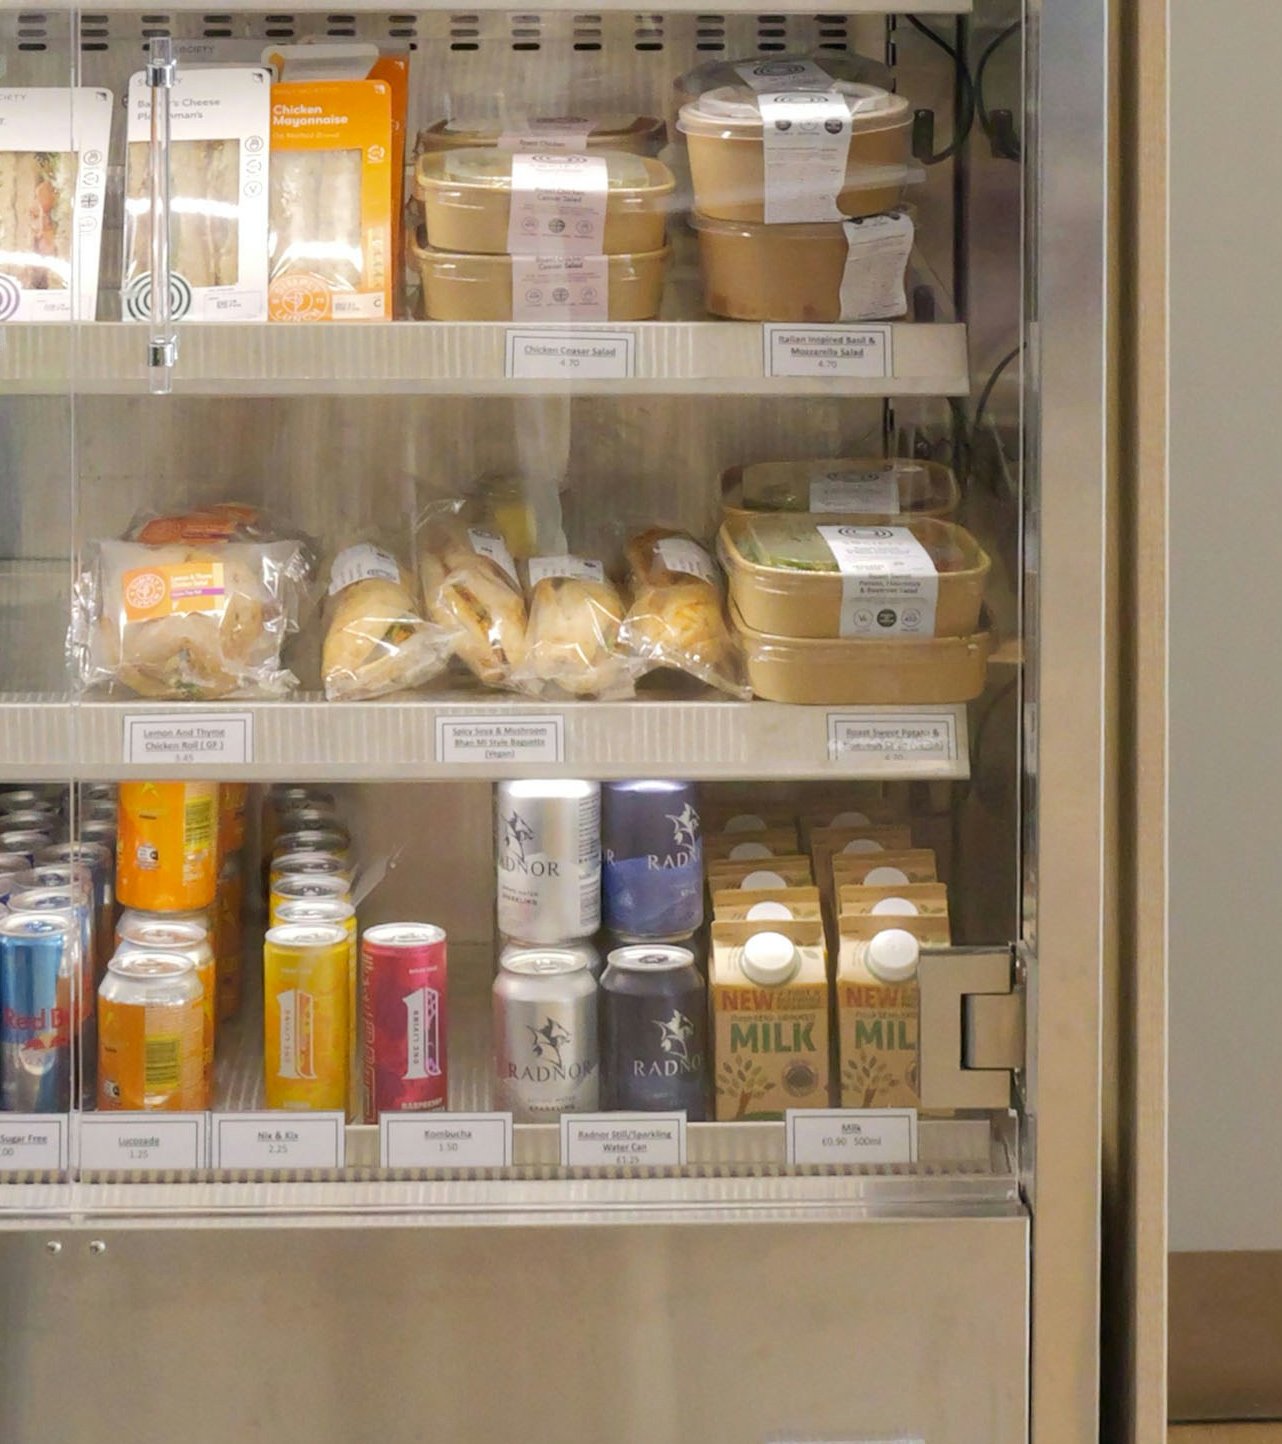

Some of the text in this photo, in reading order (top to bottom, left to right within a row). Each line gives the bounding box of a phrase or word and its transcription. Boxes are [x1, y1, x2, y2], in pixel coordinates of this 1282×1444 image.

[721, 989, 775, 1011] NEW
[846, 988, 899, 1009] NEW
[730, 1022, 817, 1053] MILK
[509, 1061, 595, 1083] RADNOR
[424, 1129, 472, 1140] Kombucha
[841, 1123, 862, 1134] Milk
[854, 1136, 882, 1147] 500ml
